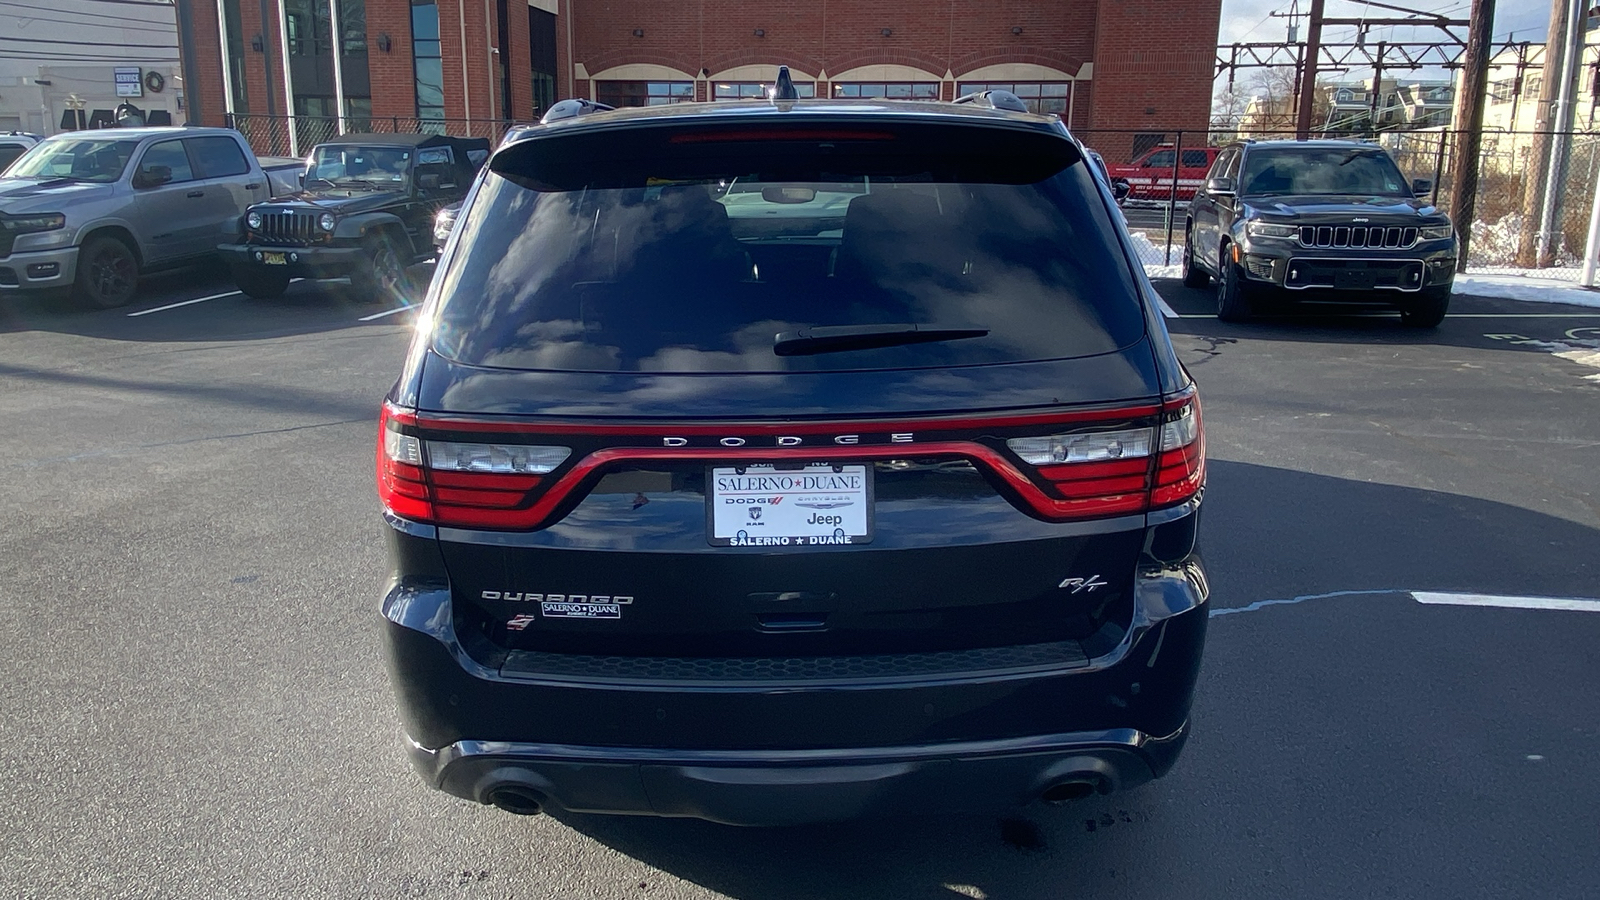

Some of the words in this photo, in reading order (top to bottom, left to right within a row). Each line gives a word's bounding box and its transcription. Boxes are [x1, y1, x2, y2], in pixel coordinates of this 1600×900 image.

[116, 73, 140, 83] SERVICE
[663, 432, 914, 447] DODGE
[718, 476, 793, 491] SALERNO
[802, 475, 861, 490] DUANE
[807, 512, 843, 527] Jeep
[730, 536, 790, 547] SALERNO
[809, 535, 852, 546] DUANE
[1058, 574, 1108, 595] R/T
[481, 590, 635, 605] DURANGO
[544, 603, 581, 612] SALERNO
[588, 605, 618, 613] DUANE
